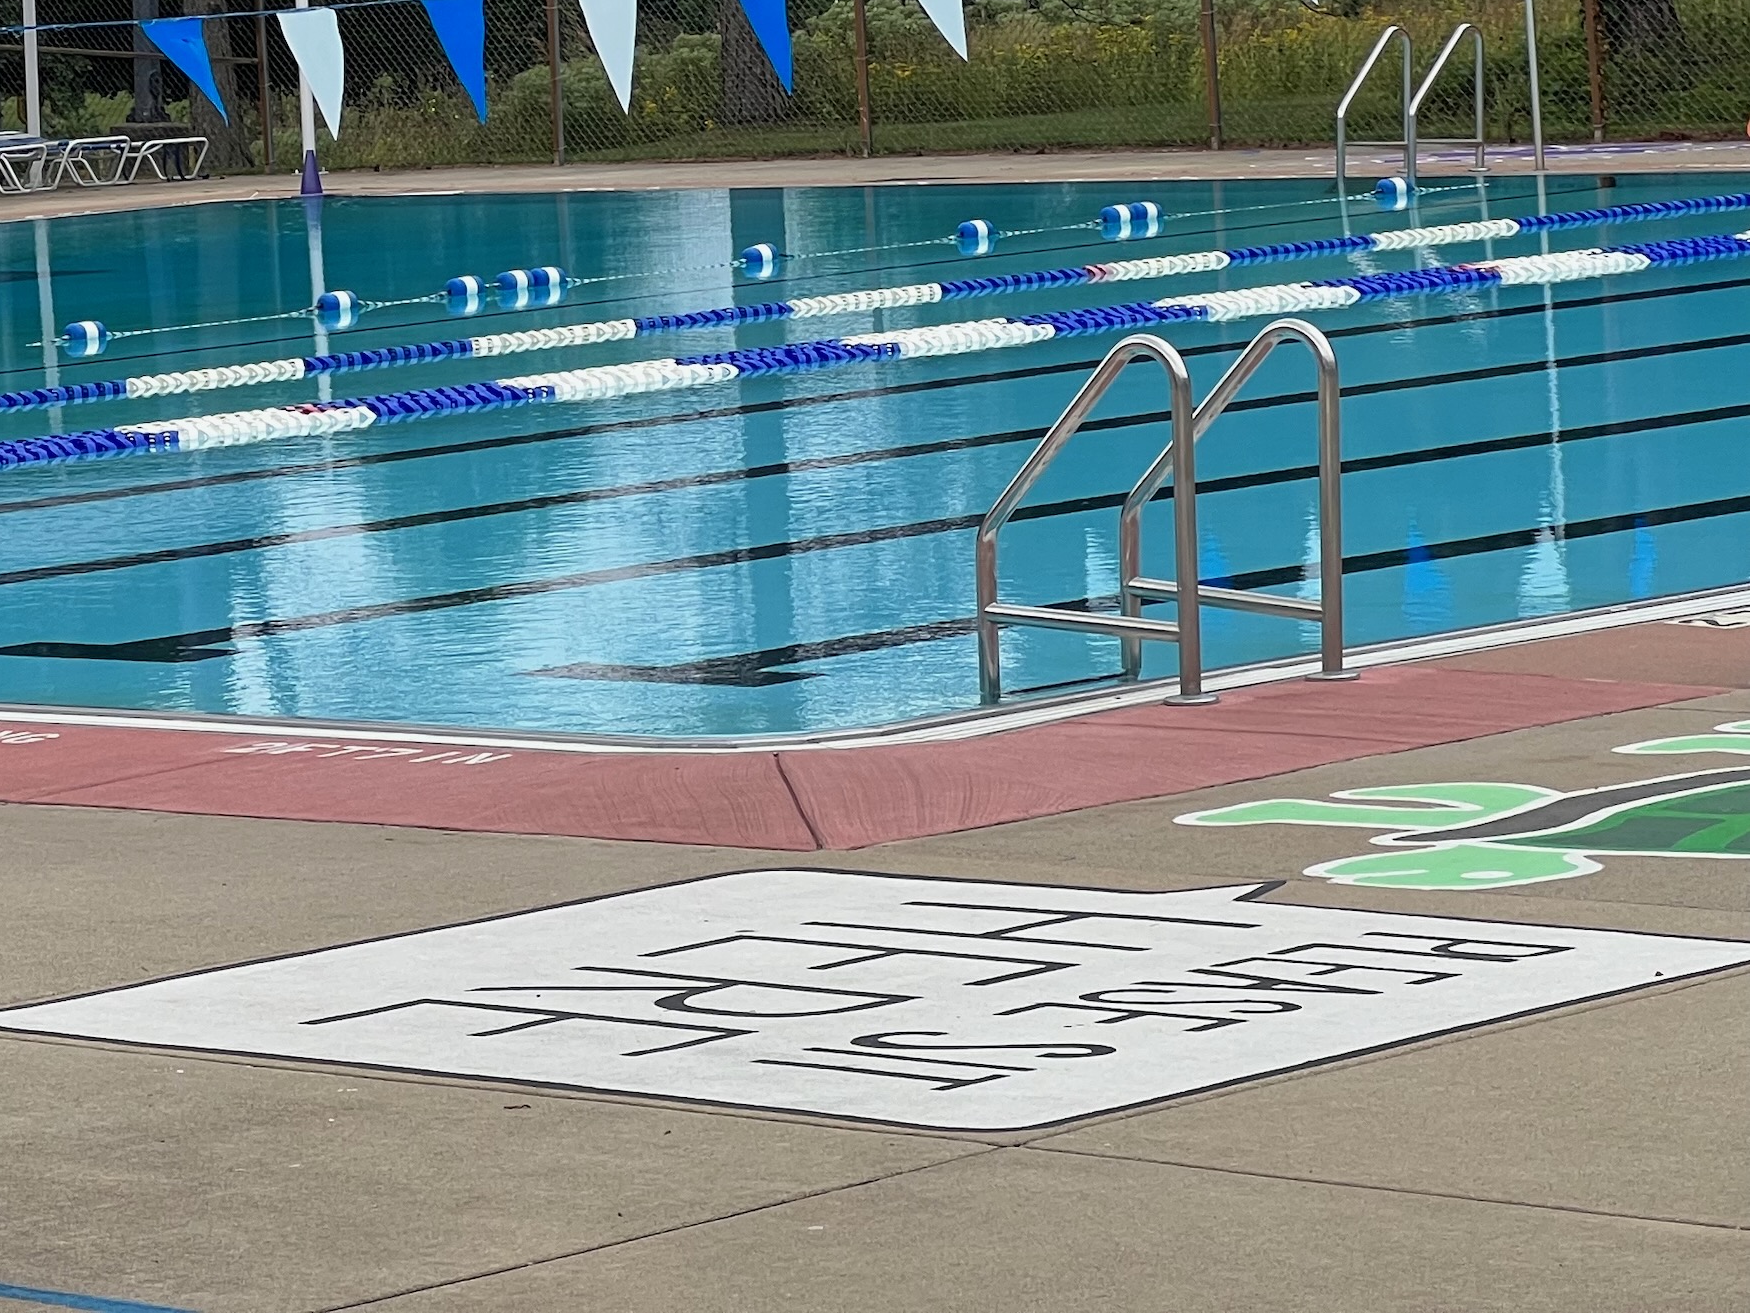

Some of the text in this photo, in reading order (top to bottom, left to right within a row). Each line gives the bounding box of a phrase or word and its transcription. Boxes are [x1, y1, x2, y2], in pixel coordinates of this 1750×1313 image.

[299, 900, 1263, 1057] HERE
[752, 931, 1575, 1092] PLEASE SIT
